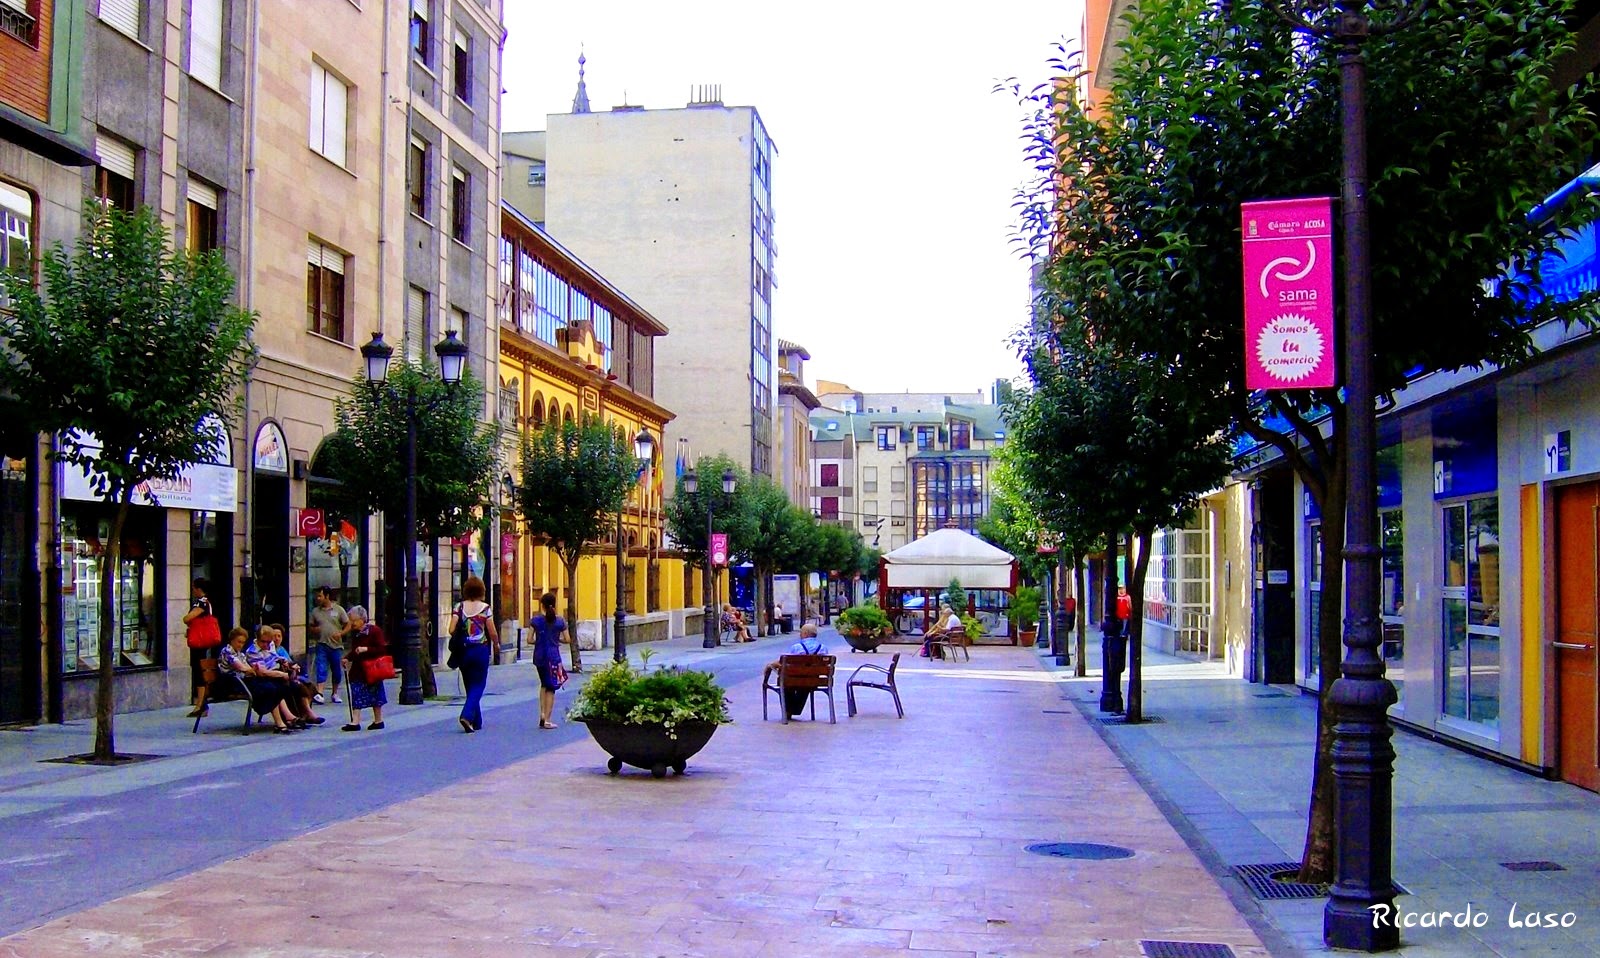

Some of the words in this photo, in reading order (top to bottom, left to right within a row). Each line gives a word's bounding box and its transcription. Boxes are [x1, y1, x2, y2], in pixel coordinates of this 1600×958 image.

[1304, 219, 1326, 229] ACOSA
[1279, 289, 1317, 301] sama
[1272, 324, 1309, 334] Somos
[1282, 338, 1300, 353] tu
[1267, 354, 1315, 365] comercio
